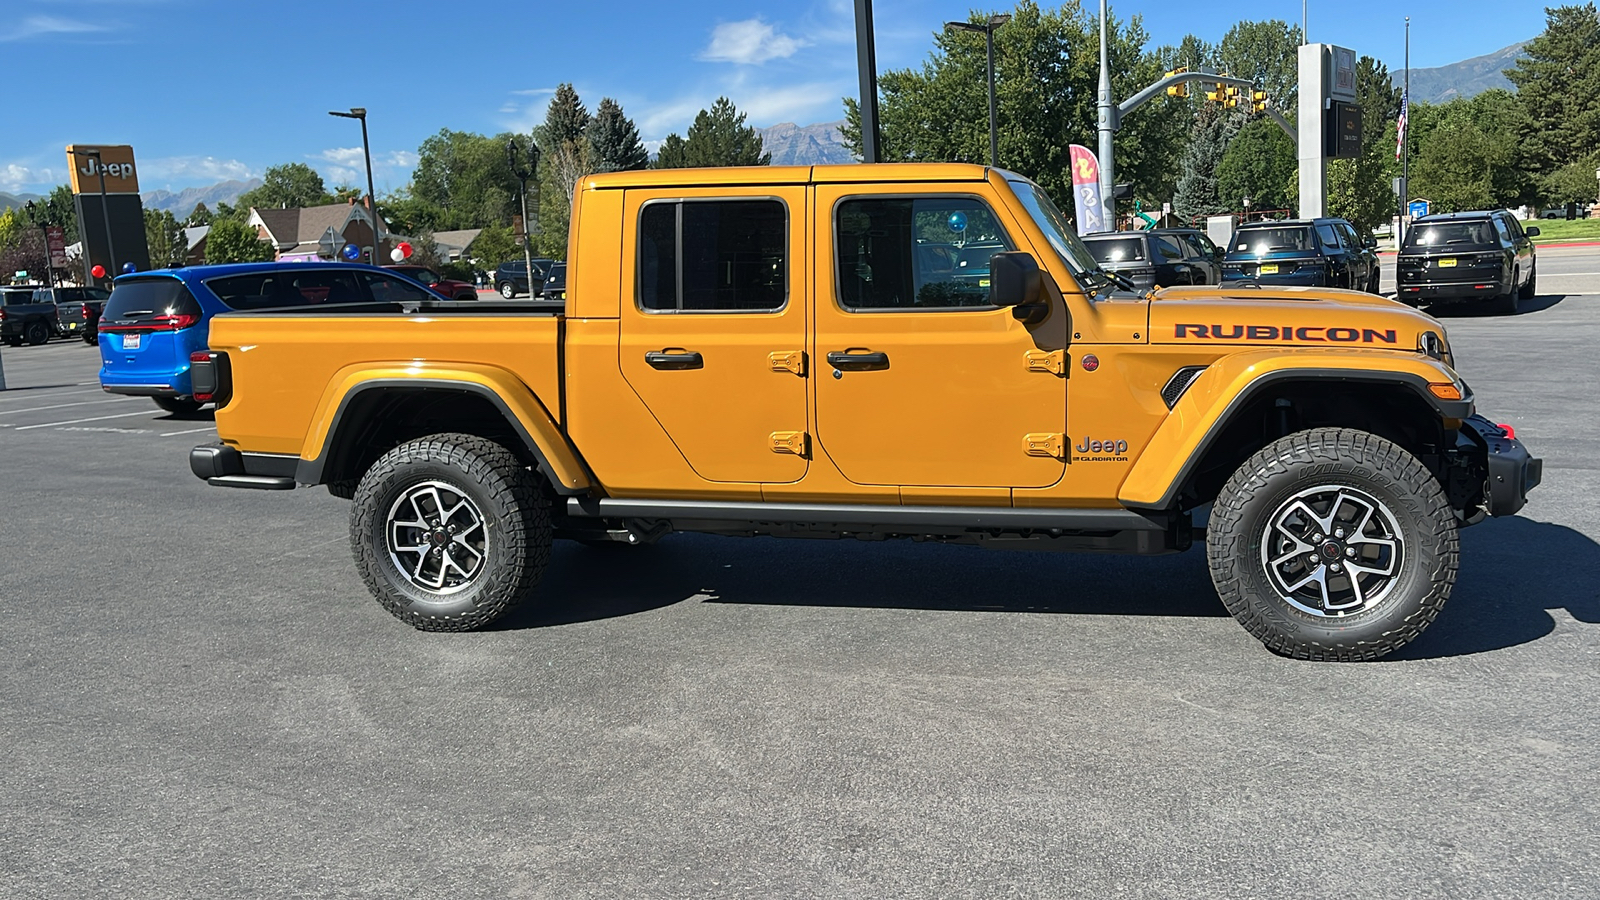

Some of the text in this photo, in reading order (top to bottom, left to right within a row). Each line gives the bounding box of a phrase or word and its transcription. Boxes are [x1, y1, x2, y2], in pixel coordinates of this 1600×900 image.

[80, 158, 134, 180] Jeep
[1174, 323, 1397, 344] RUBICON
[1075, 436, 1128, 455] Jeep
[1299, 463, 1430, 536] WILDPEAK
